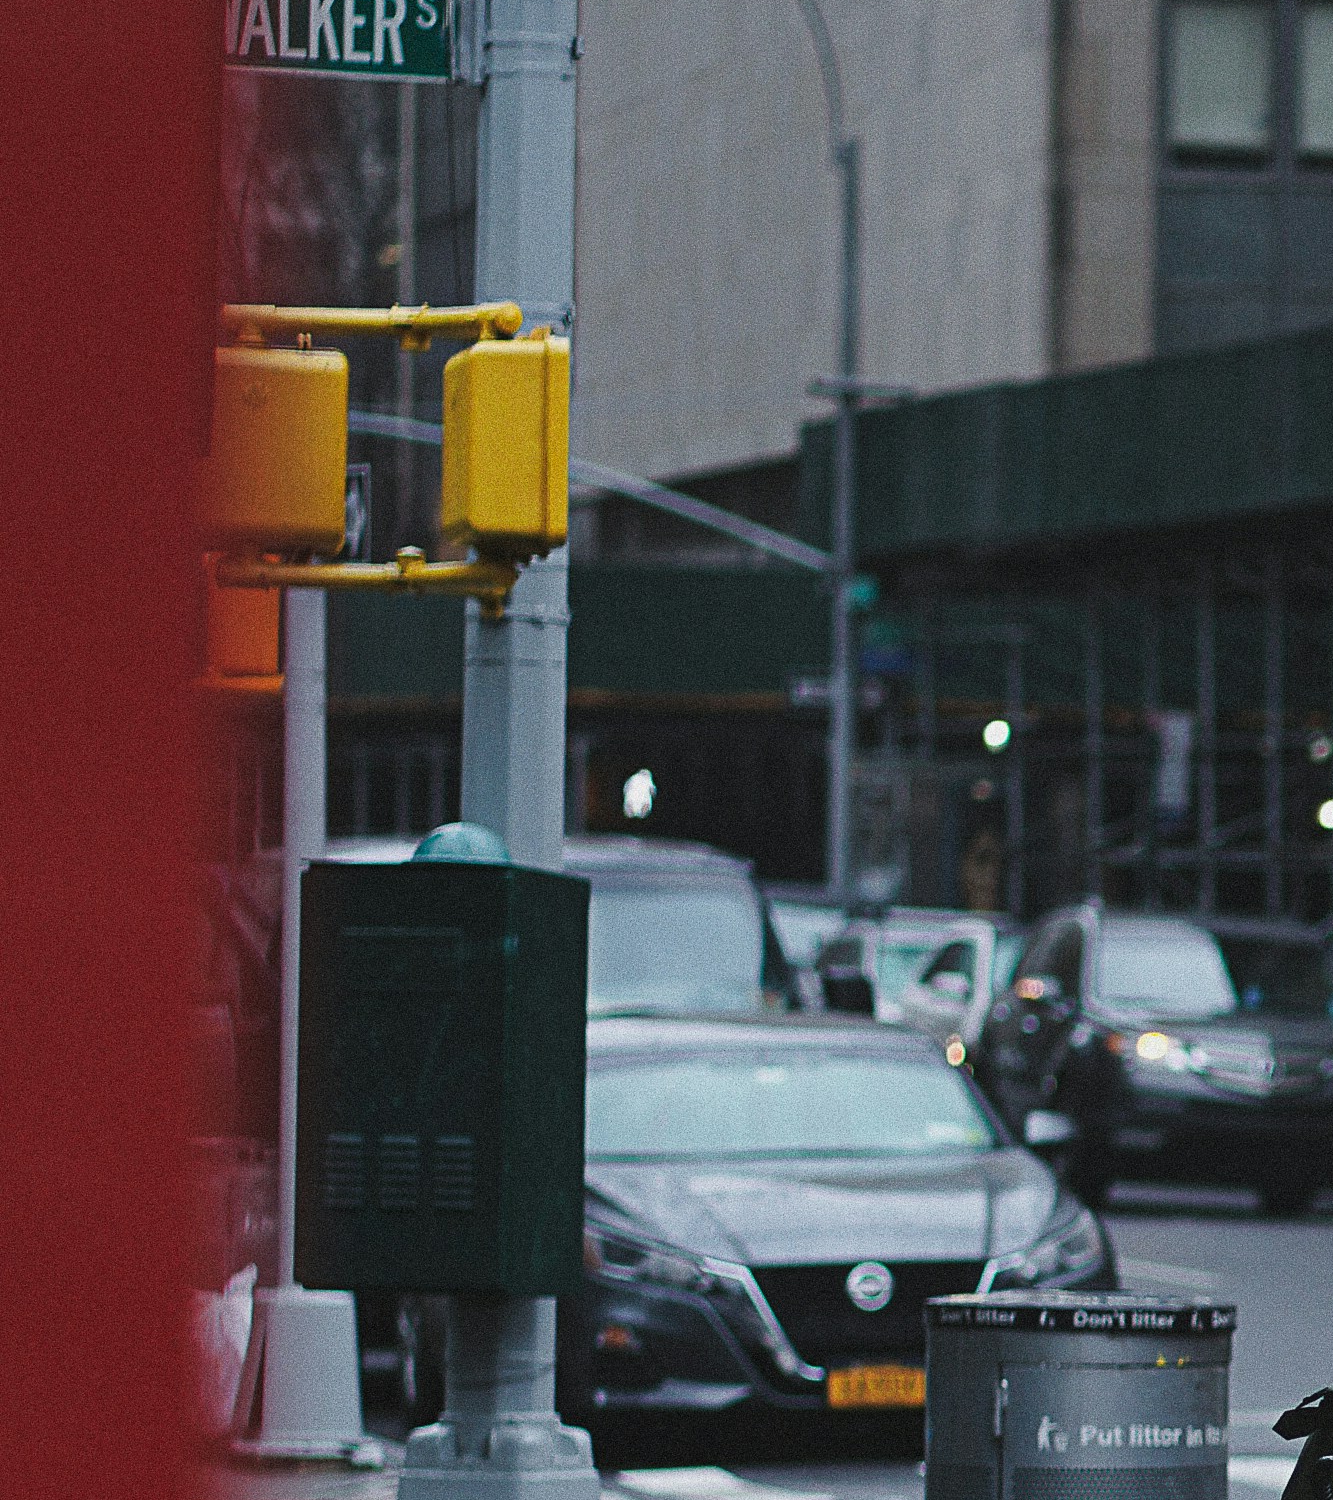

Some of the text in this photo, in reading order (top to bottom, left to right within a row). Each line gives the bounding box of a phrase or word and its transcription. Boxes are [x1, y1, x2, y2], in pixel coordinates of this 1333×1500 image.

[1073, 1310, 1176, 1328] Don't litter
[1080, 1424, 1123, 1447] Put
[1128, 1423, 1182, 1448] litter
